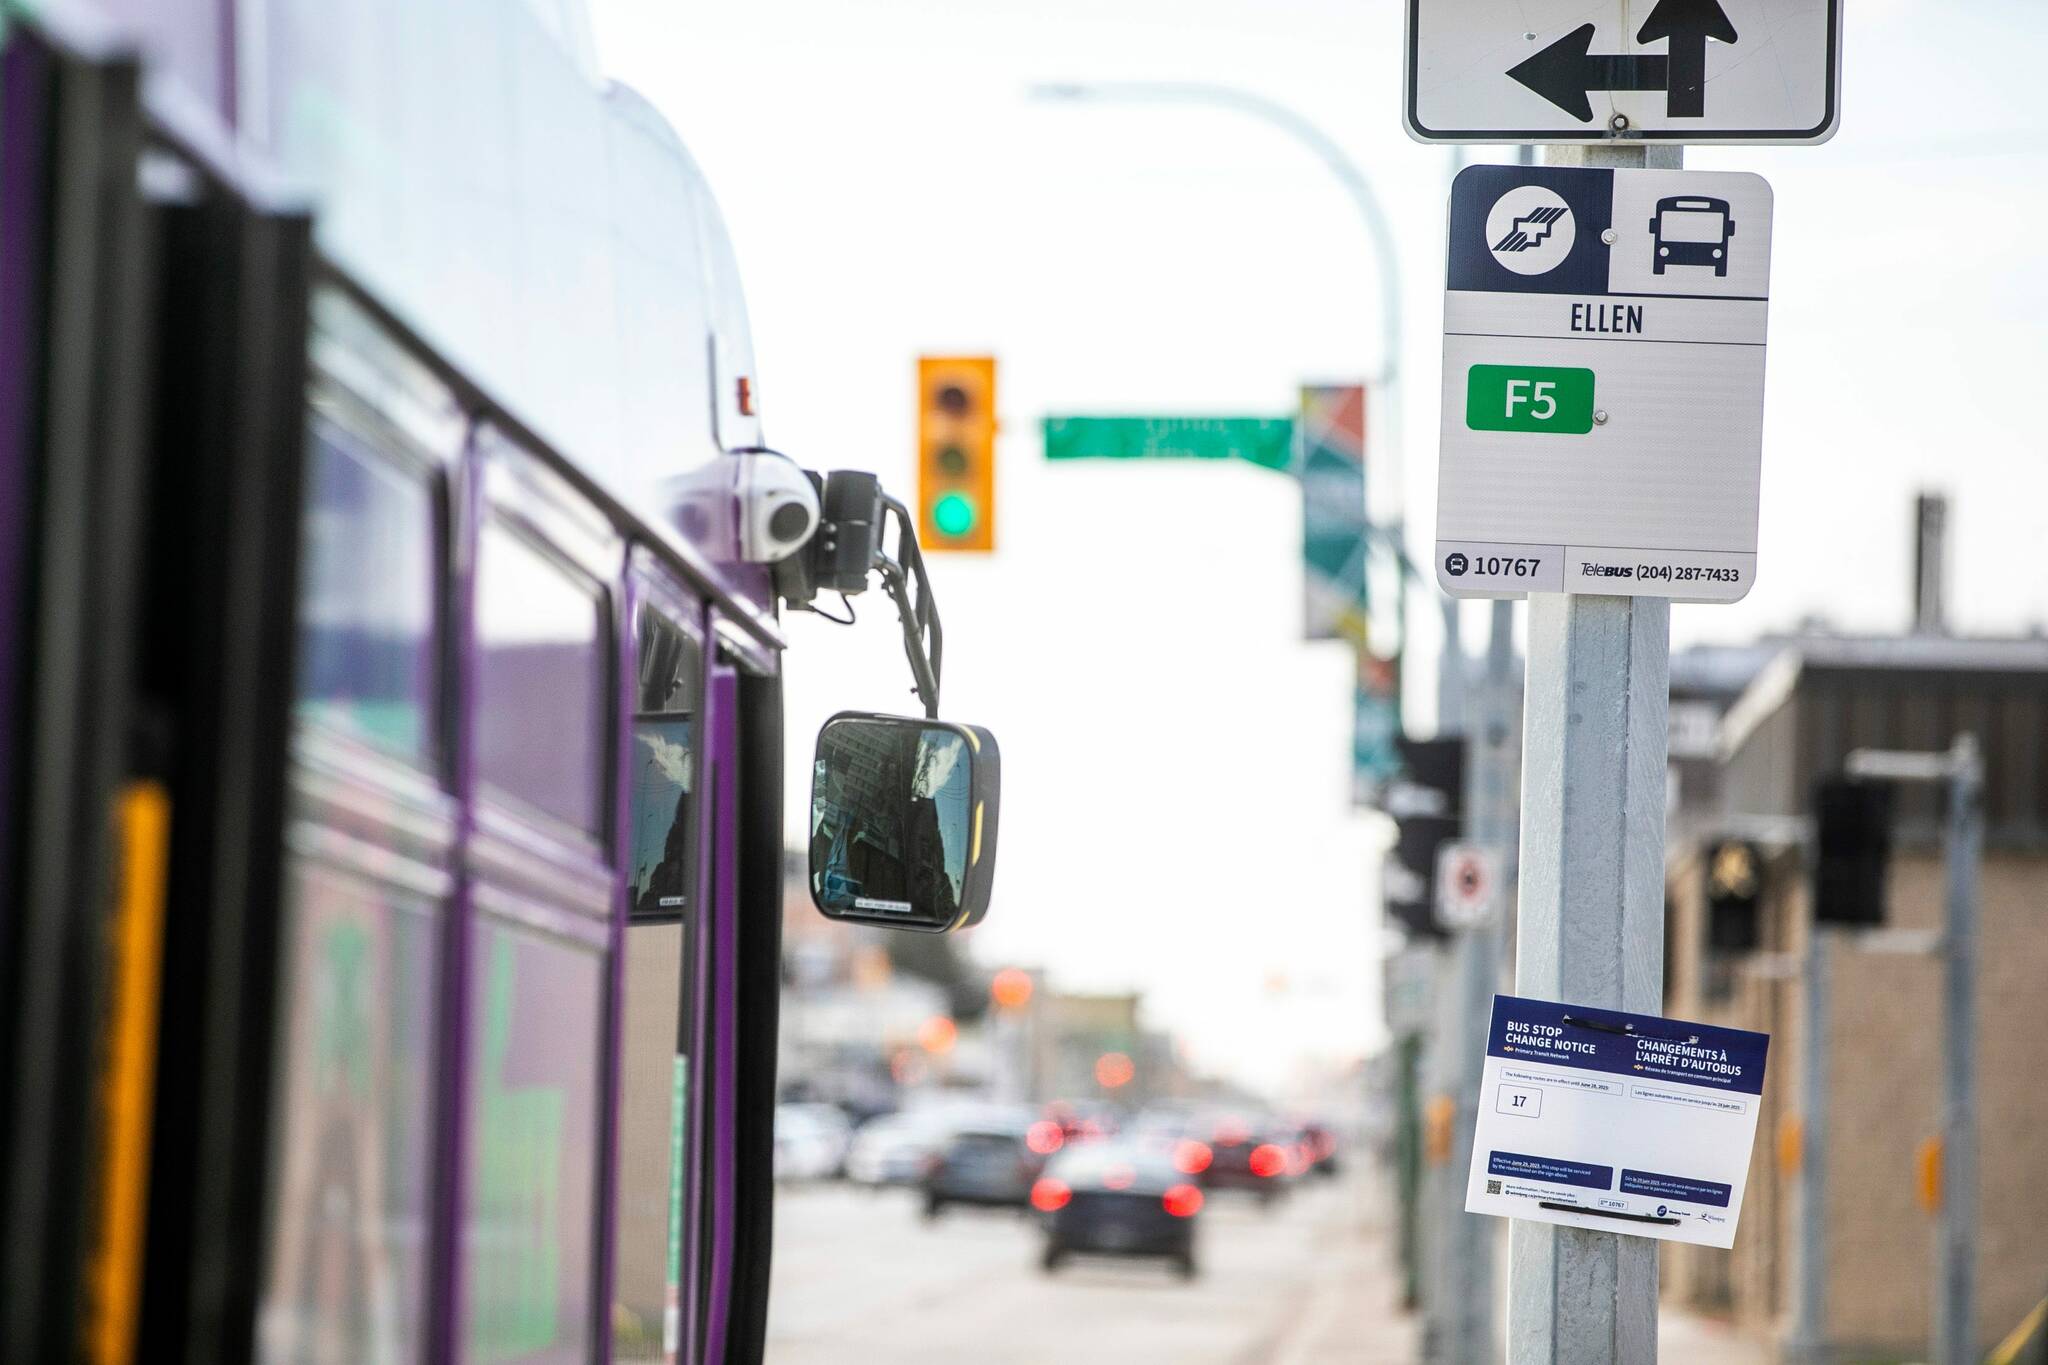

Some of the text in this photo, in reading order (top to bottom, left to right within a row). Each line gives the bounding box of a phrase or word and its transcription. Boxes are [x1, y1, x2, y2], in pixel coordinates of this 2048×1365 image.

[1571, 303, 1643, 333] ELLEN
[1505, 379, 1557, 419] F5
[1474, 556, 1541, 577] 10767
[1581, 562, 1739, 582] TeleBUS (204) 287-7433
[1507, 1021, 1563, 1038] BUS STOP
[1505, 1033, 1596, 1054] CHANGE NOTICE
[1515, 1047, 1533, 1055] Primary
[1637, 1040, 1728, 1062] CHANGEMENTS À
[1635, 1049, 1742, 1076] L’ARRÊT D’AUTOBUS
[1667, 1070, 1688, 1078] transport
[1712, 1076, 1732, 1084] principal
[1512, 1095, 1527, 1108] 17
